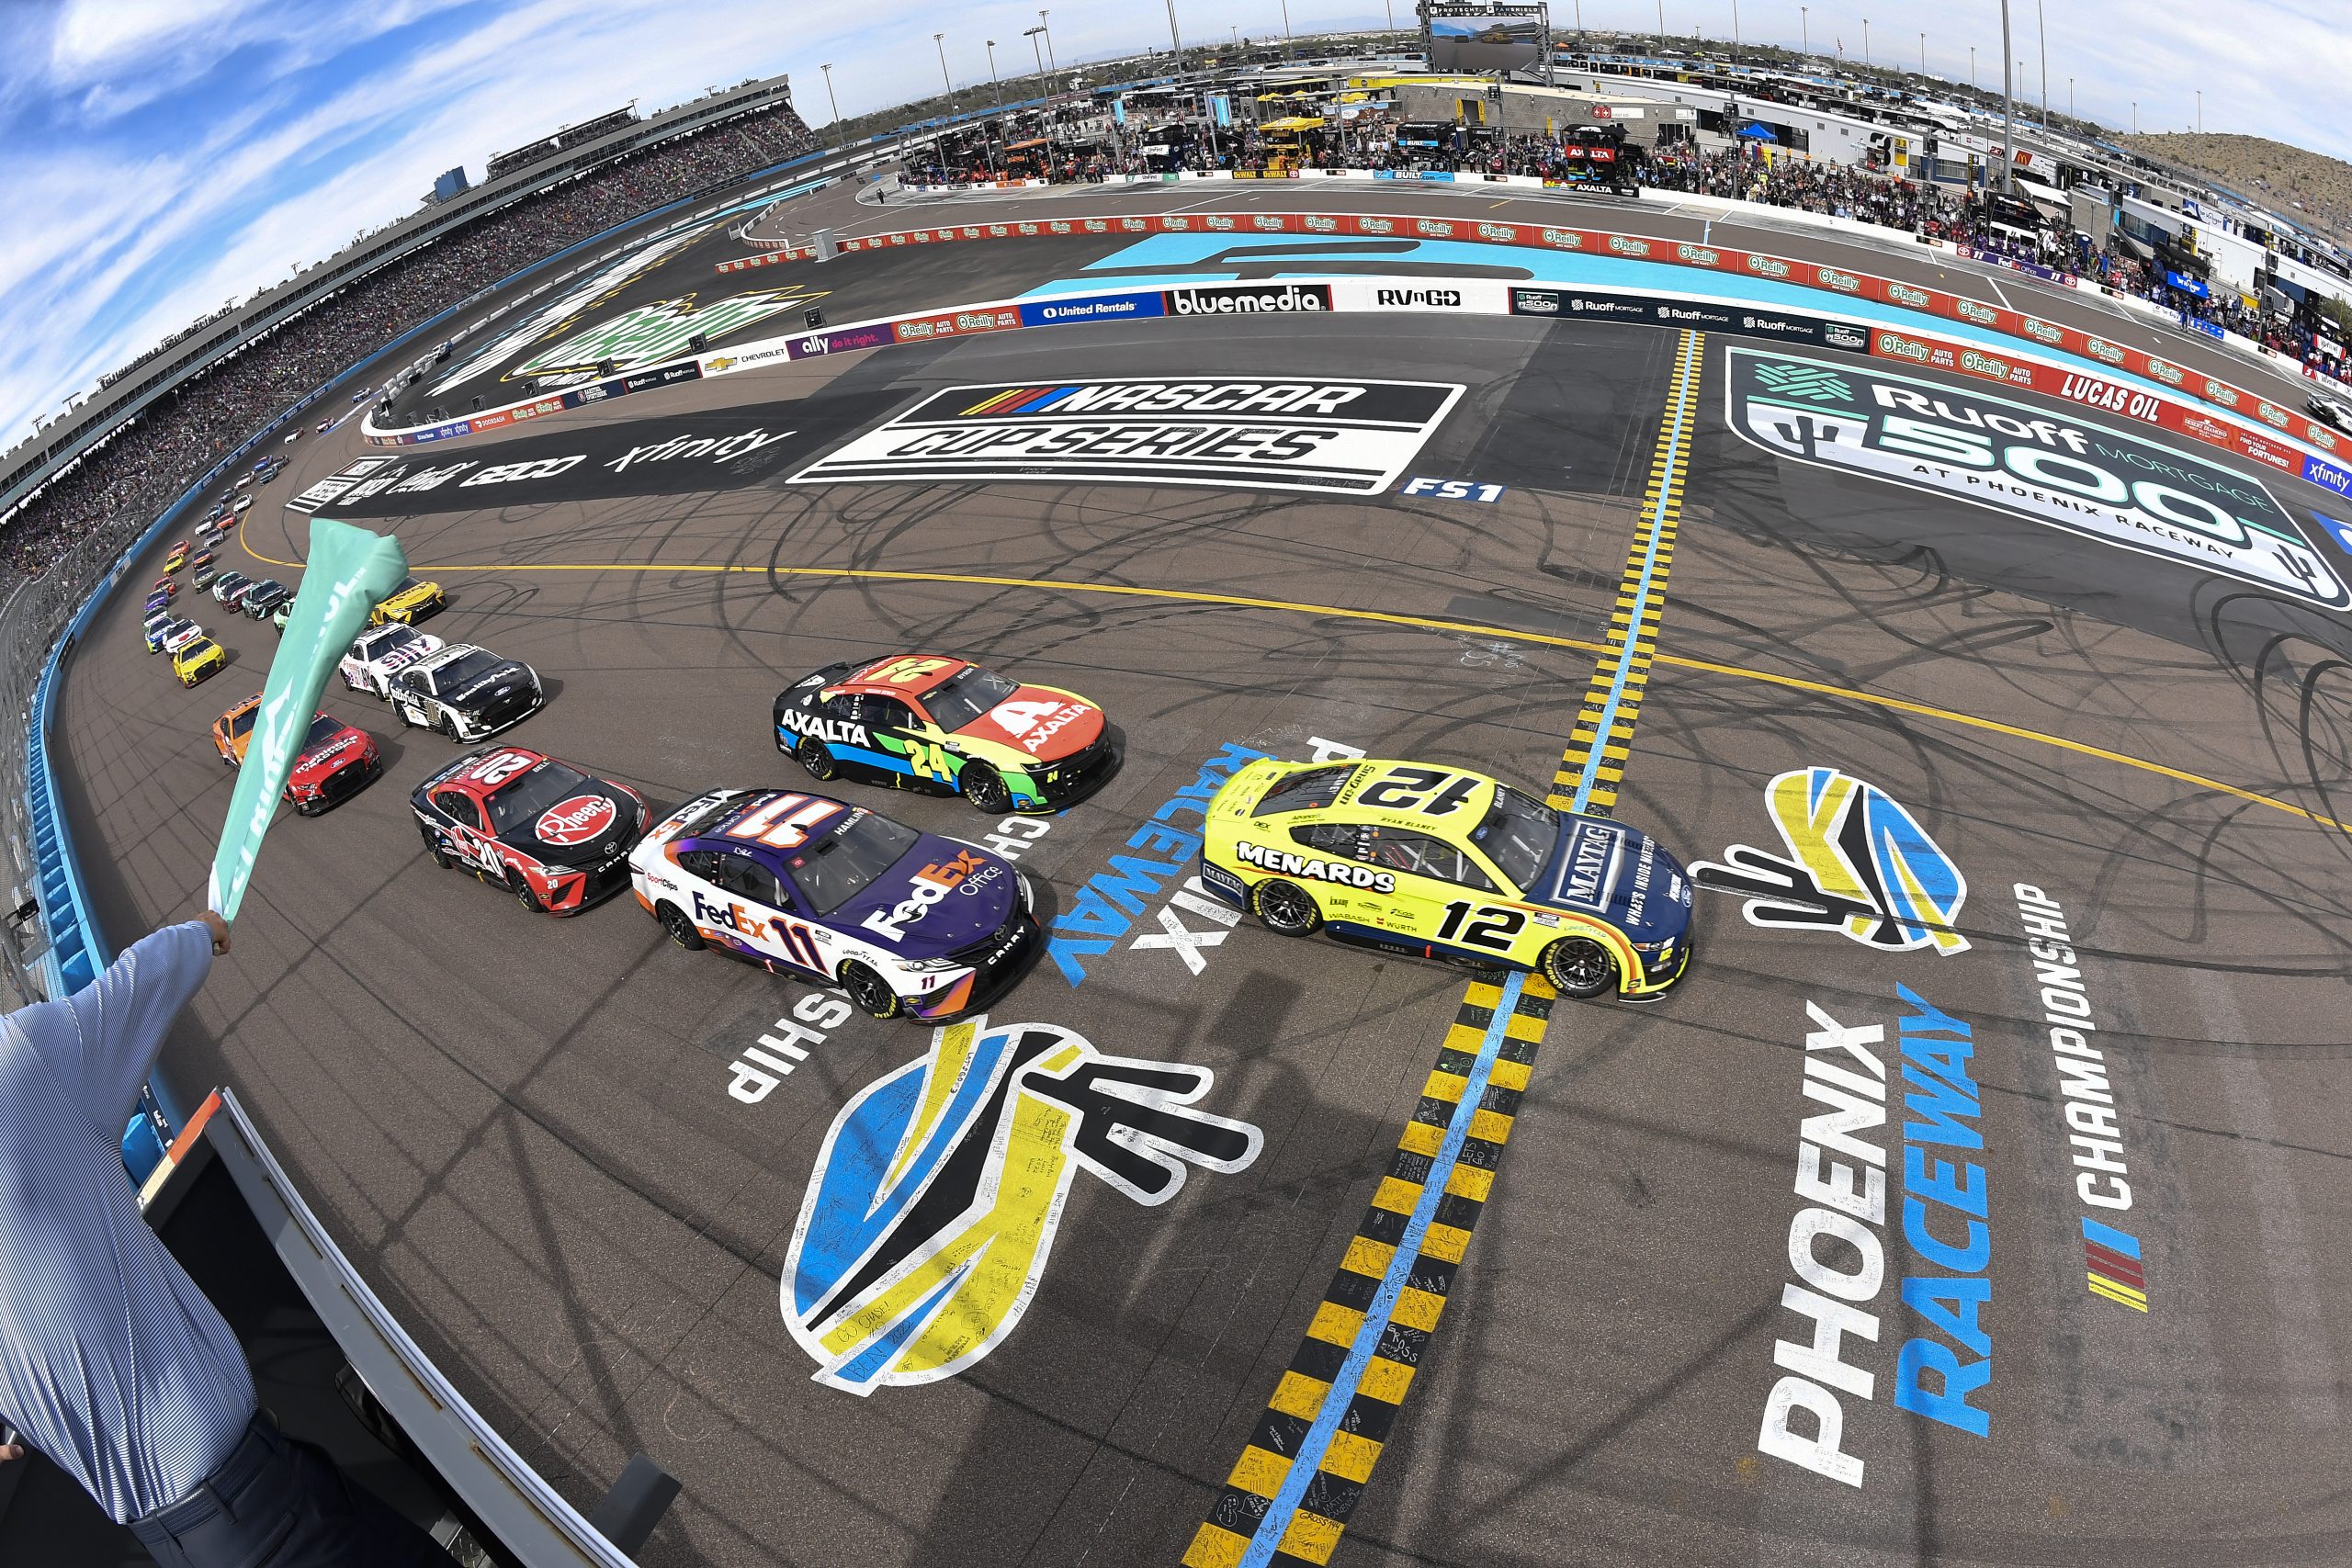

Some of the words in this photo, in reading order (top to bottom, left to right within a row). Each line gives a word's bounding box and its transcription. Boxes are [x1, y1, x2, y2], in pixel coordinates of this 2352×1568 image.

[1570, 149, 1609, 158] AXLTA
[1577, 184, 1612, 193] AXALTA
[1123, 219, 1145, 229] O'Reilly
[1163, 218, 1188, 228] O'Reilly
[1207, 217, 1234, 228] O'Reilly
[1255, 217, 1283, 228] O'Reilly
[1306, 217, 1336, 228] O'Reilly
[1360, 218, 1392, 231] O'Reilly
[1418, 220, 1453, 234] O'Reilly
[1479, 223, 1515, 240] O'Reilly
[1544, 229, 1581, 247] O'Reilly
[1610, 236, 1649, 255] O'Reilly
[1678, 244, 1718, 265] O'Reilly
[1748, 255, 1789, 276] O'Reilly
[1998, 257, 2020, 269] FedEx
[2021, 266, 2037, 275] Office
[1818, 269, 1860, 290] O'Reilly
[1174, 286, 1320, 313] bluemedia
[1889, 283, 1929, 306] O'Reilly
[1058, 306, 1093, 317] United
[1096, 302, 1136, 312] Rentals
[1586, 301, 1614, 311] Ruoff
[1615, 305, 1643, 313] MORTGAGE
[1672, 309, 1701, 320] Ruoff
[1958, 301, 1997, 323] O'Reilly
[899, 322, 933, 338] O'Reilly
[935, 326, 954, 334] PARTS
[957, 313, 995, 330] O'Reilly
[997, 318, 1016, 326] PARTS
[1758, 319, 1785, 331] Ruoff
[1786, 325, 1814, 333] MORTGAGE
[2025, 318, 2063, 343] O'Reilly
[741, 348, 785, 363] CHEVROLET
[802, 336, 828, 354] ally
[832, 340, 842, 348] do
[854, 334, 878, 347] right.
[1880, 335, 1930, 360] O'Reilly
[1933, 348, 1952, 359] AUTO
[2088, 339, 2124, 363] O'Reilly
[1931, 355, 1954, 367] PARTS
[1961, 351, 2009, 379] O'Reilly
[2012, 367, 2030, 378] AUTO
[2149, 358, 2183, 383] O'Reilly
[2009, 373, 2031, 385] PARTS
[1039, 384, 1367, 413] NASCAR
[2061, 374, 2129, 412] LUCAS
[2129, 393, 2160, 423] OIL
[2207, 379, 2238, 405] O'Reilly
[2259, 402, 2289, 427] O'Reilly
[888, 429, 1034, 457] CUP
[1023, 426, 1340, 461] SERIES
[2204, 426, 2228, 439] DIAMOND
[2239, 436, 2252, 447] FIND
[2252, 441, 2267, 451] YOUR
[2308, 424, 2336, 449] O'Reilly
[605, 428, 797, 473] xfinity
[1871, 384, 2091, 455] Ruoff
[2095, 443, 2274, 513] MORTGAGE
[2247, 446, 2290, 468] FORTUNES!
[459, 455, 588, 488] GEICO
[1879, 416, 2247, 543] 500
[2309, 463, 2351, 492] xfinity
[1404, 478, 1507, 502] FS1
[1913, 465, 1949, 479] AT
[1967, 476, 2100, 516] PHOENIX
[2116, 514, 2233, 558] RACEWAY
[864, 658, 953, 683] 24
[957, 667, 974, 681] BYRON
[456, 667, 521, 701] Smithfield
[782, 708, 871, 749] AXALTA
[1022, 703, 1091, 753] AXALTA
[296, 734, 358, 773] mahindra
[903, 739, 954, 783] 24
[469, 753, 535, 784] 20
[532, 761, 550, 773] BELL
[1046, 770, 1058, 784] 24
[1358, 767, 1482, 816] 12
[1495, 785, 1506, 809] BLANEY
[739, 793, 778, 816] FedEx
[540, 795, 612, 843] Rheem
[649, 799, 717, 840] FedEx
[727, 795, 843, 848] 11
[834, 811, 865, 836] HAMLIN
[1380, 816, 1403, 826] RYAN
[1404, 819, 1438, 831] BLANEY
[472, 837, 505, 879] 20
[1238, 840, 1396, 895] MENARDS
[1566, 825, 1613, 903] MAYTAG
[547, 879, 558, 889] 20
[960, 864, 1003, 897] Office
[1204, 866, 1243, 892] MAYTAG
[1634, 863, 1652, 891] INSIDE
[860, 849, 988, 942] FedEx
[692, 891, 770, 942] FedEx
[1329, 913, 1370, 923] WABASH
[1437, 901, 1527, 953] 12
[768, 917, 831, 976] 11
[987, 923, 1026, 965] CAMRY
[842, 950, 879, 967] GOODYEAR
[922, 976, 936, 990] 11
[2013, 882, 2133, 1212] CHAMPIONSHIP
[1895, 981, 1991, 1438] RACEWAY
[1758, 998, 1887, 1489] PHOENIX
[837, 1325, 858, 1343] GO
[858, 1300, 890, 1329] CHASE!
